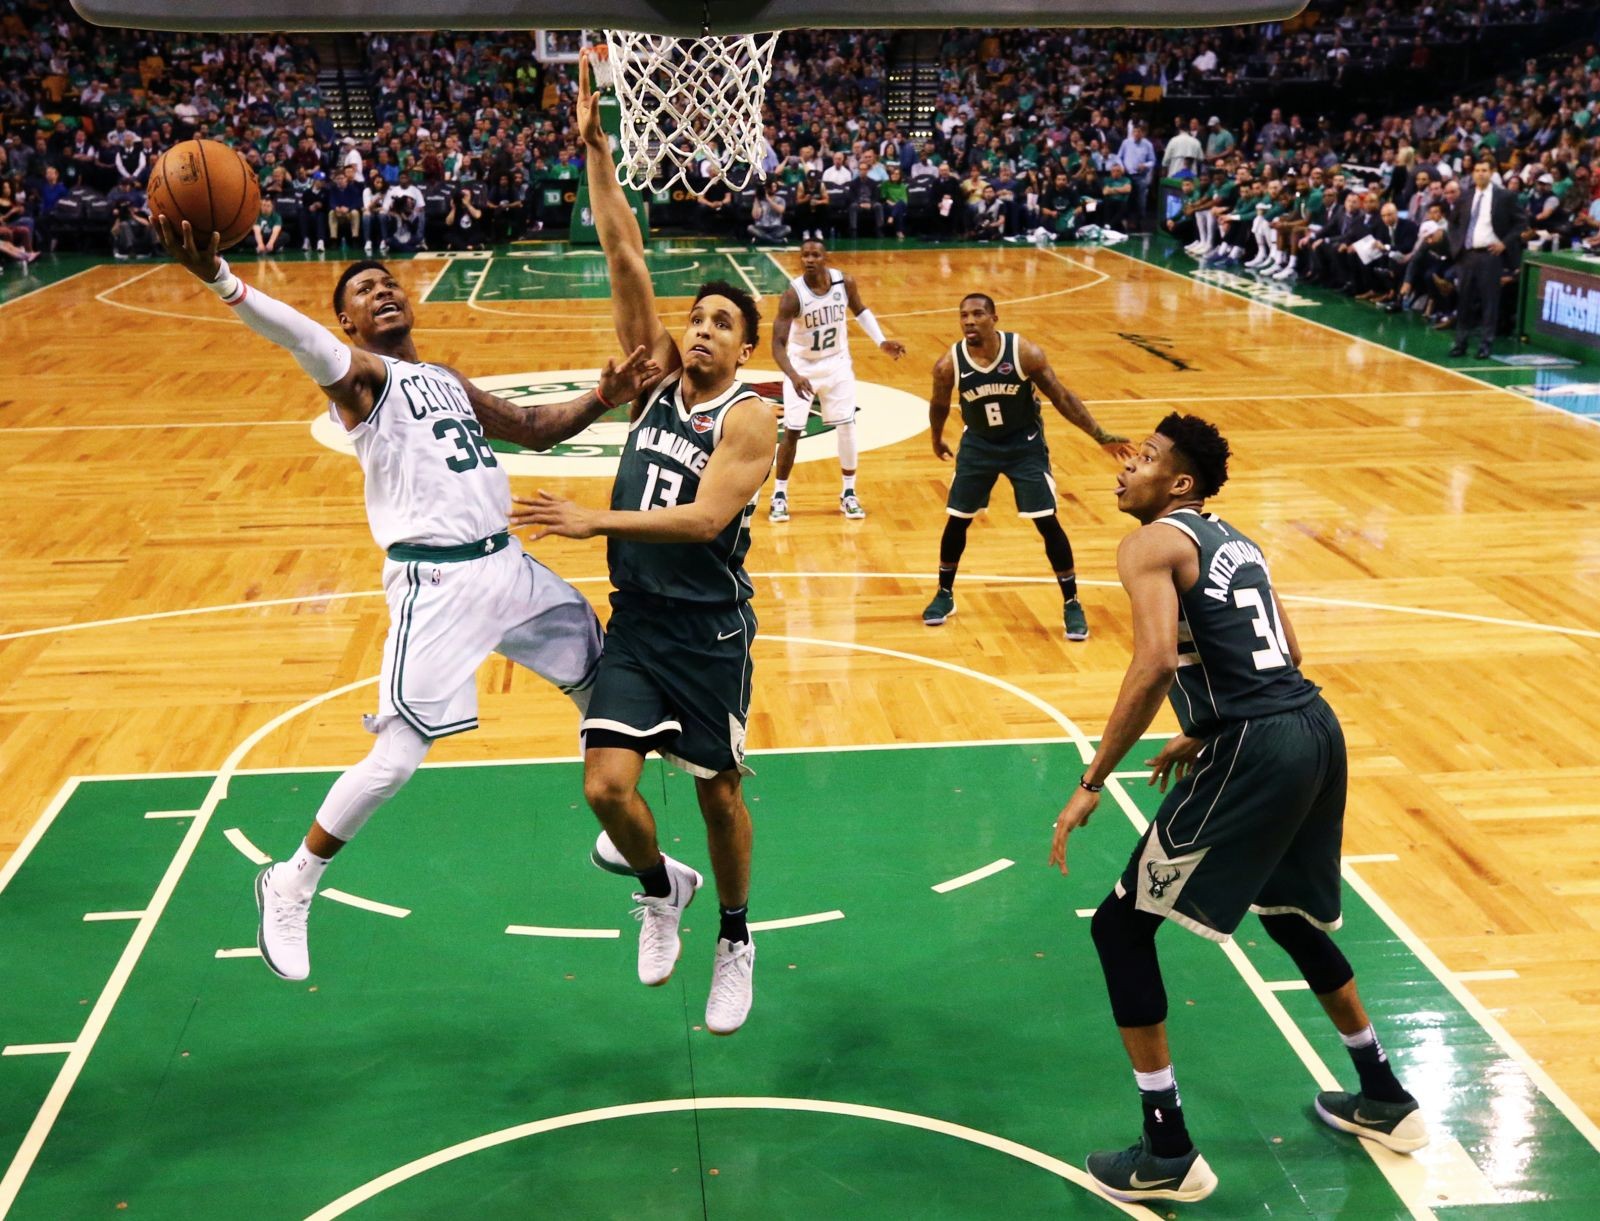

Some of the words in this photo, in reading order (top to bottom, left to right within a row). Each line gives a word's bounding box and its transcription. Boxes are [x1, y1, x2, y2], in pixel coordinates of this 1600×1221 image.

[804, 304, 845, 329] CELTICS
[810, 327, 837, 351] 12
[400, 374, 472, 421] CELTIC
[984, 402, 1004, 427] 6
[432, 417, 498, 474] 36
[636, 426, 710, 479] MILWAUKE
[640, 463, 684, 512] 13
